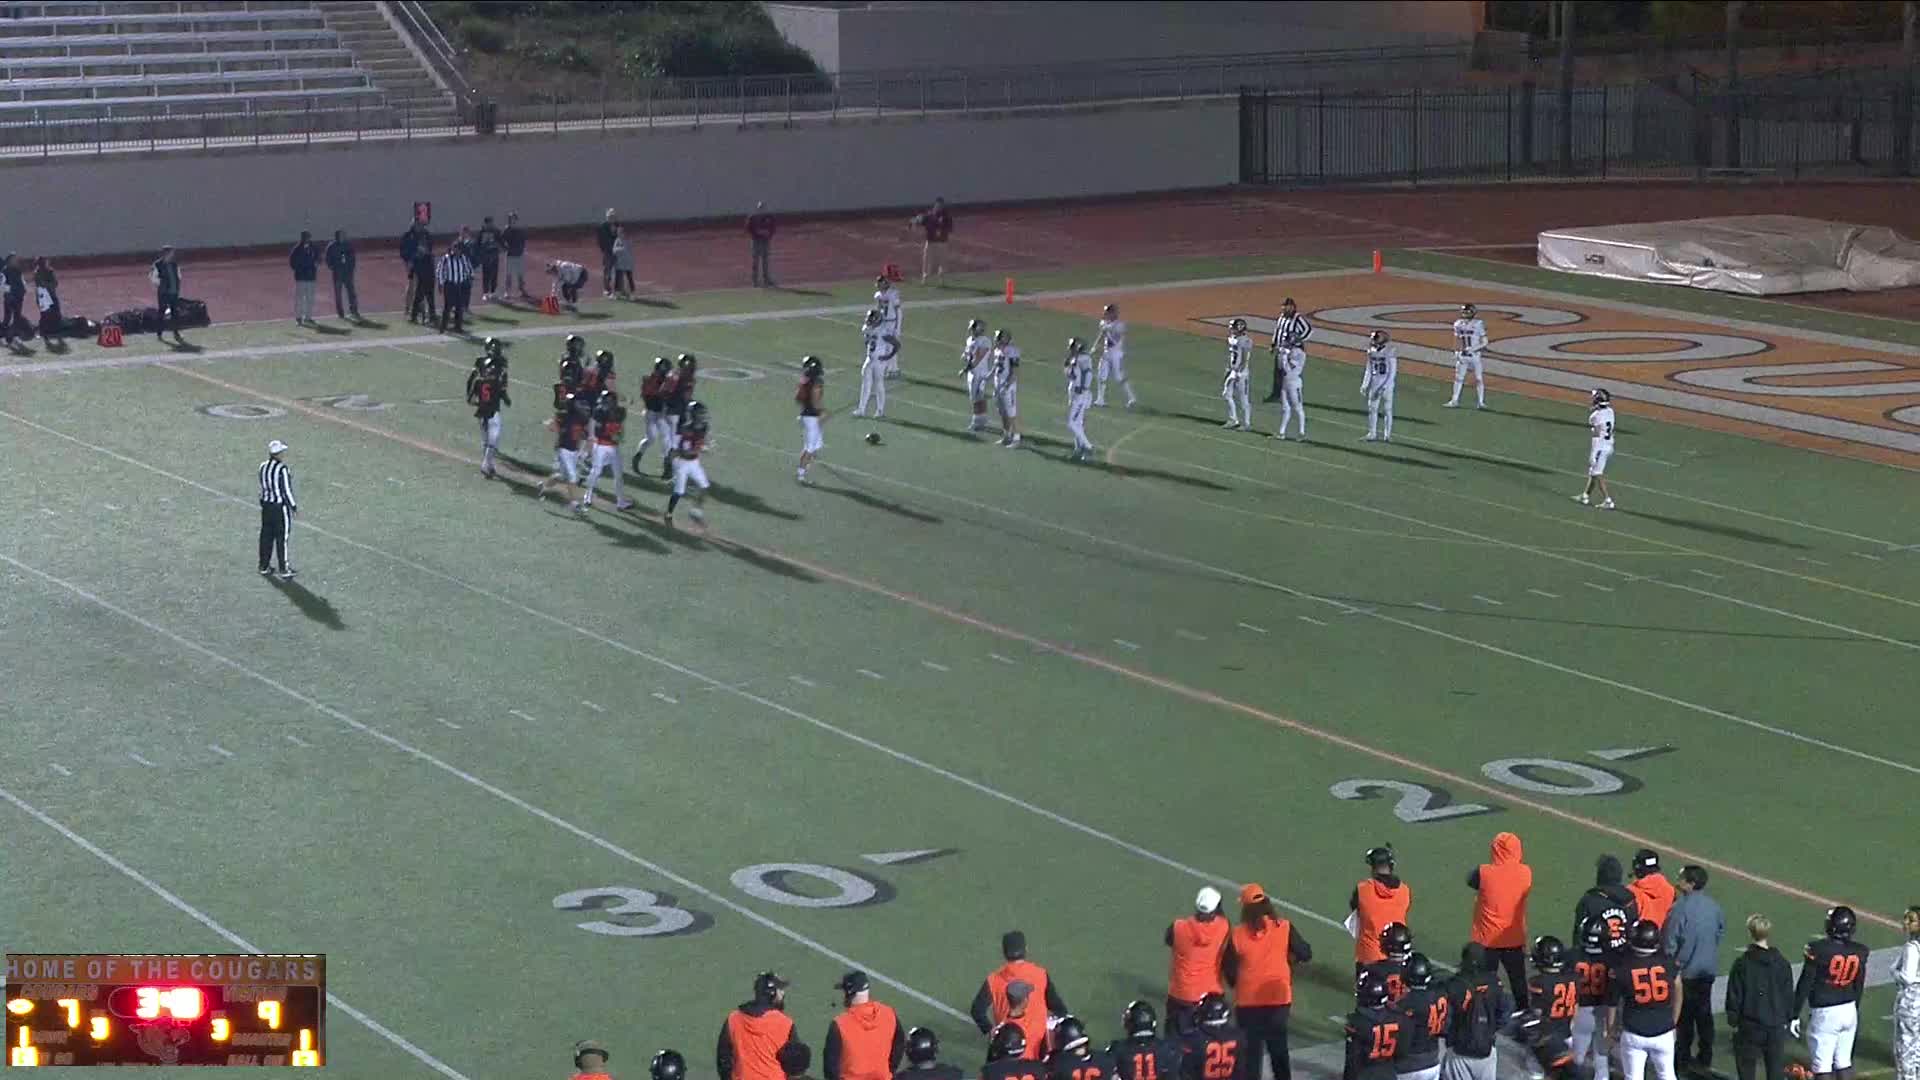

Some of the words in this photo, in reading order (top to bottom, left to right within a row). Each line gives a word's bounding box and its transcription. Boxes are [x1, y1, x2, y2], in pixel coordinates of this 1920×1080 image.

[1328, 757, 1625, 823] 20
[552, 862, 877, 937] 30
[1631, 965, 1670, 1004] 56
[1826, 954, 1861, 987] 90
[1550, 981, 1577, 1018] 24
[1204, 1040, 1238, 1078] 25
[1369, 1023, 1399, 1059] 15
[1132, 1053, 1157, 1080] 11
